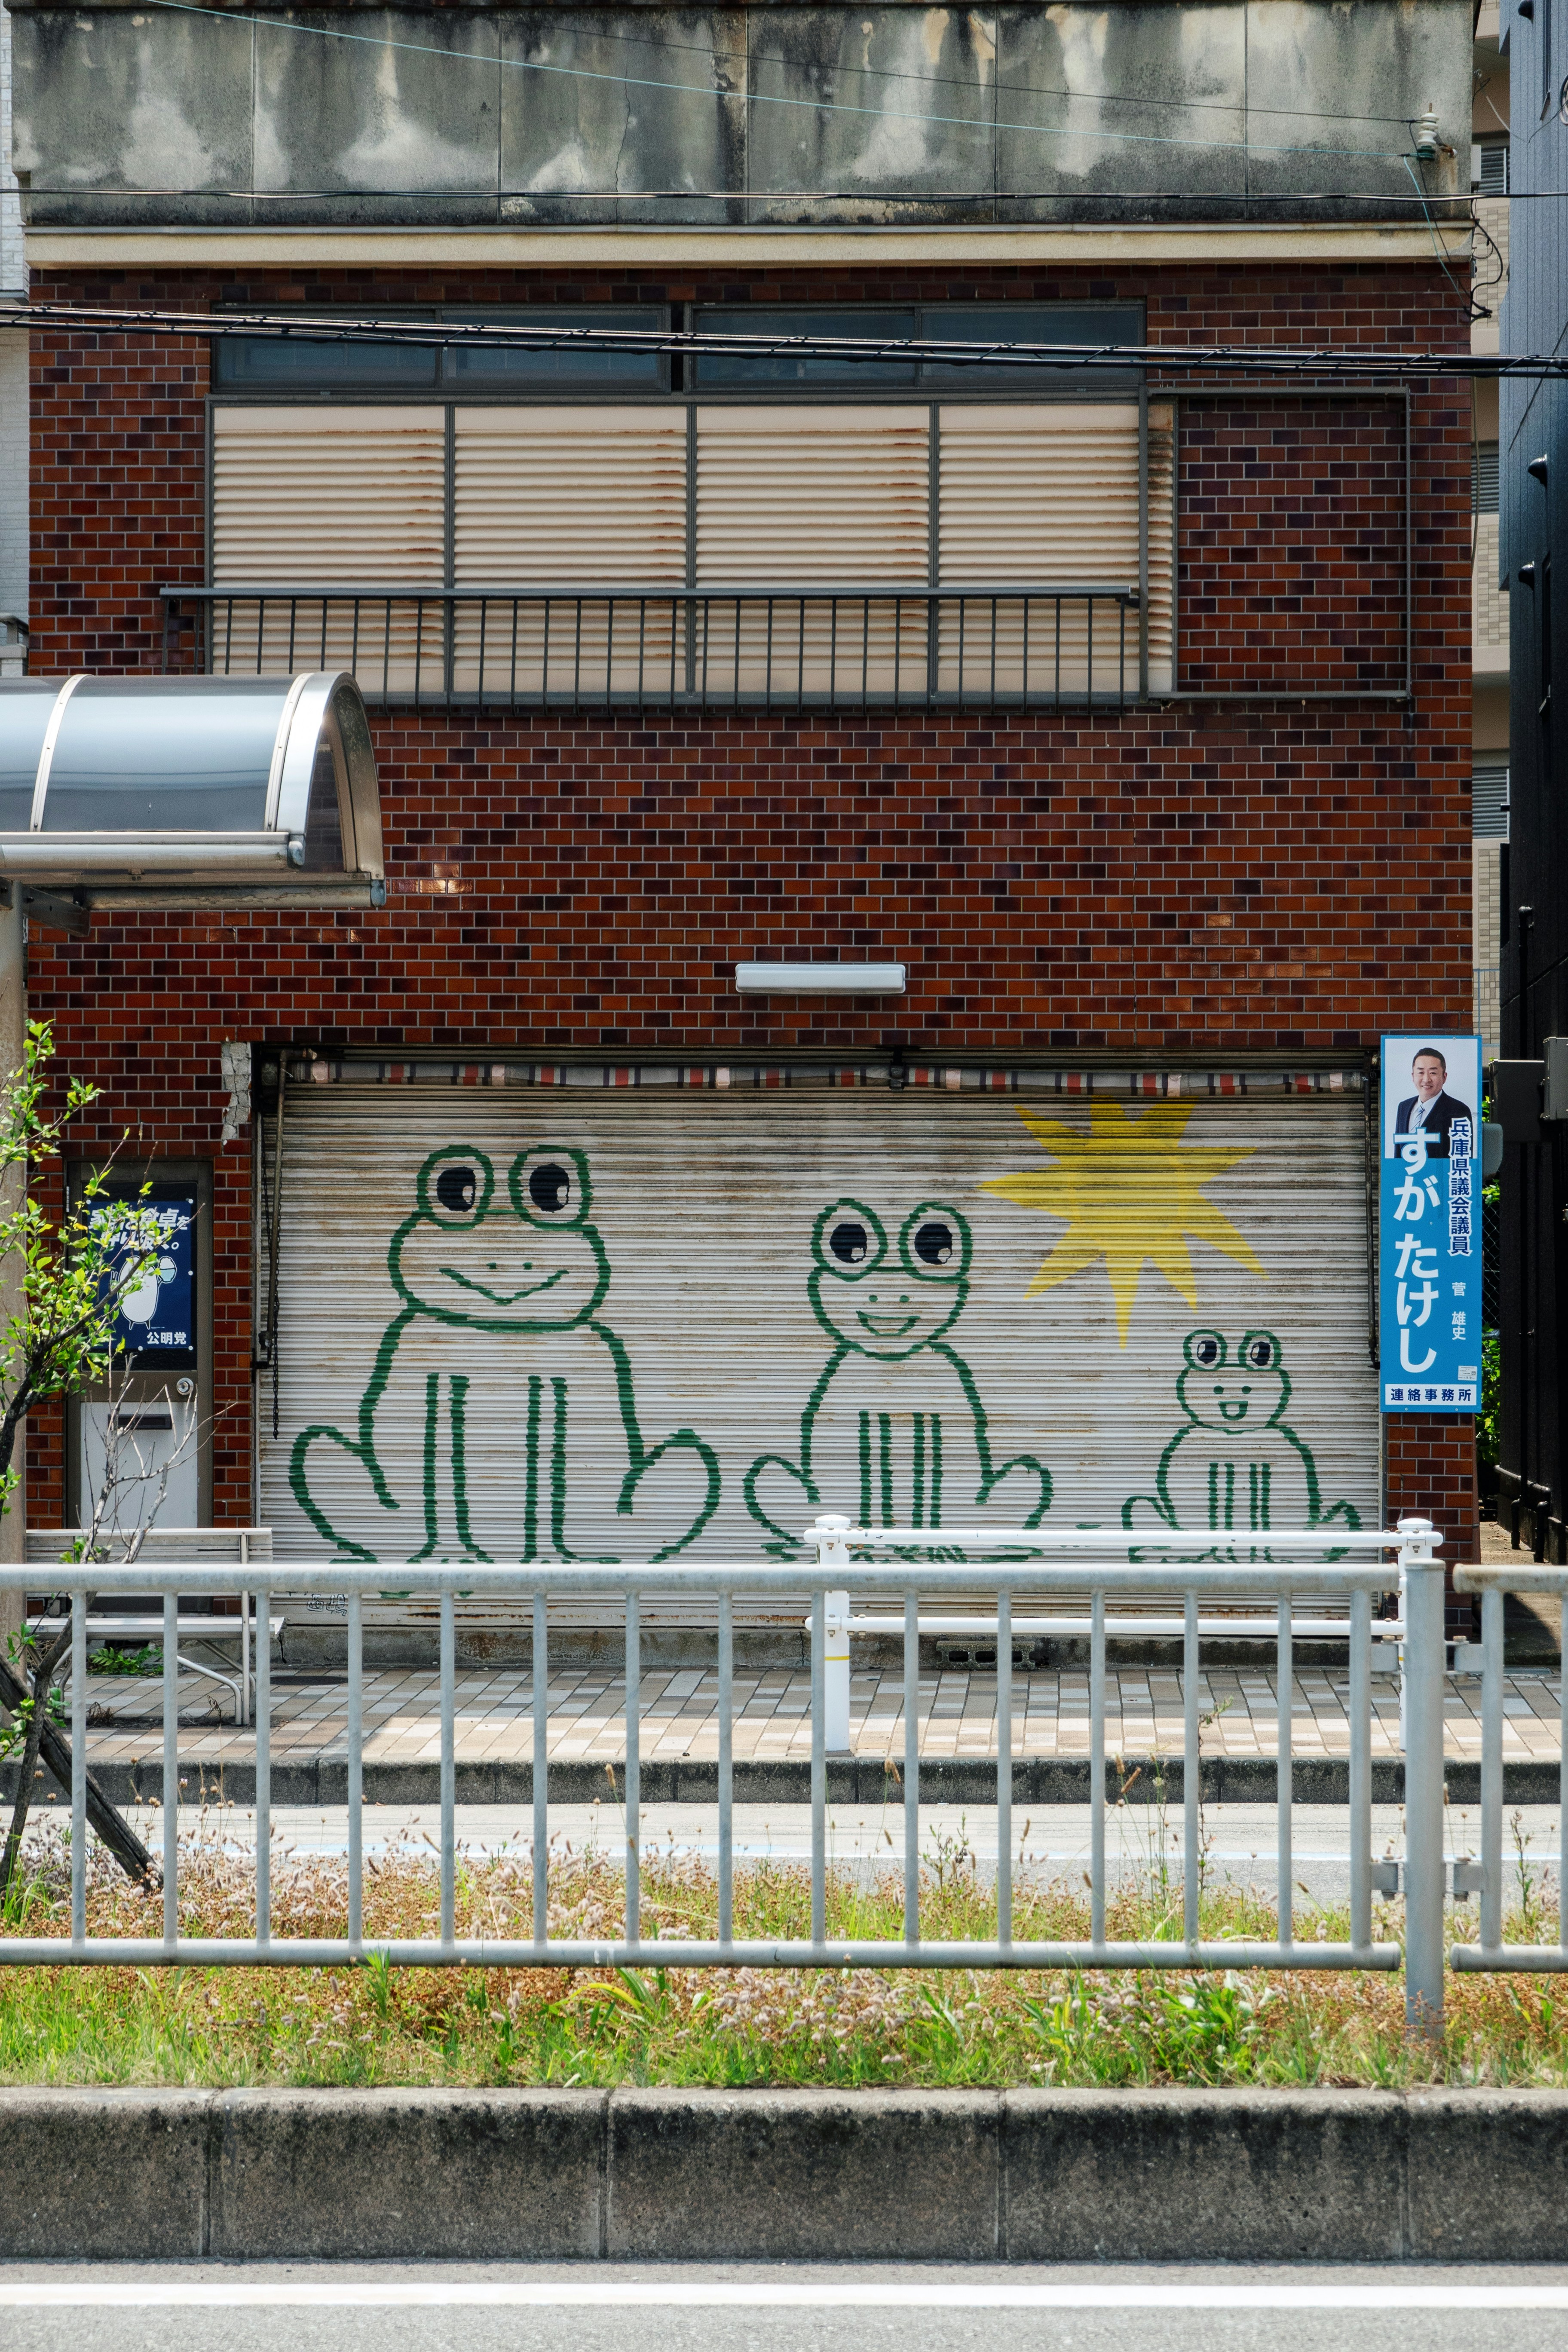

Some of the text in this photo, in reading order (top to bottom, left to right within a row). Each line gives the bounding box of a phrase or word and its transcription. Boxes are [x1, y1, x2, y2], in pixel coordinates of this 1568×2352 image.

[1449, 1118, 1472, 1256] 兵庫県議会議員
[147, 1332, 186, 1344] 公明党
[1391, 1388, 1471, 1401] 連絡事務所
